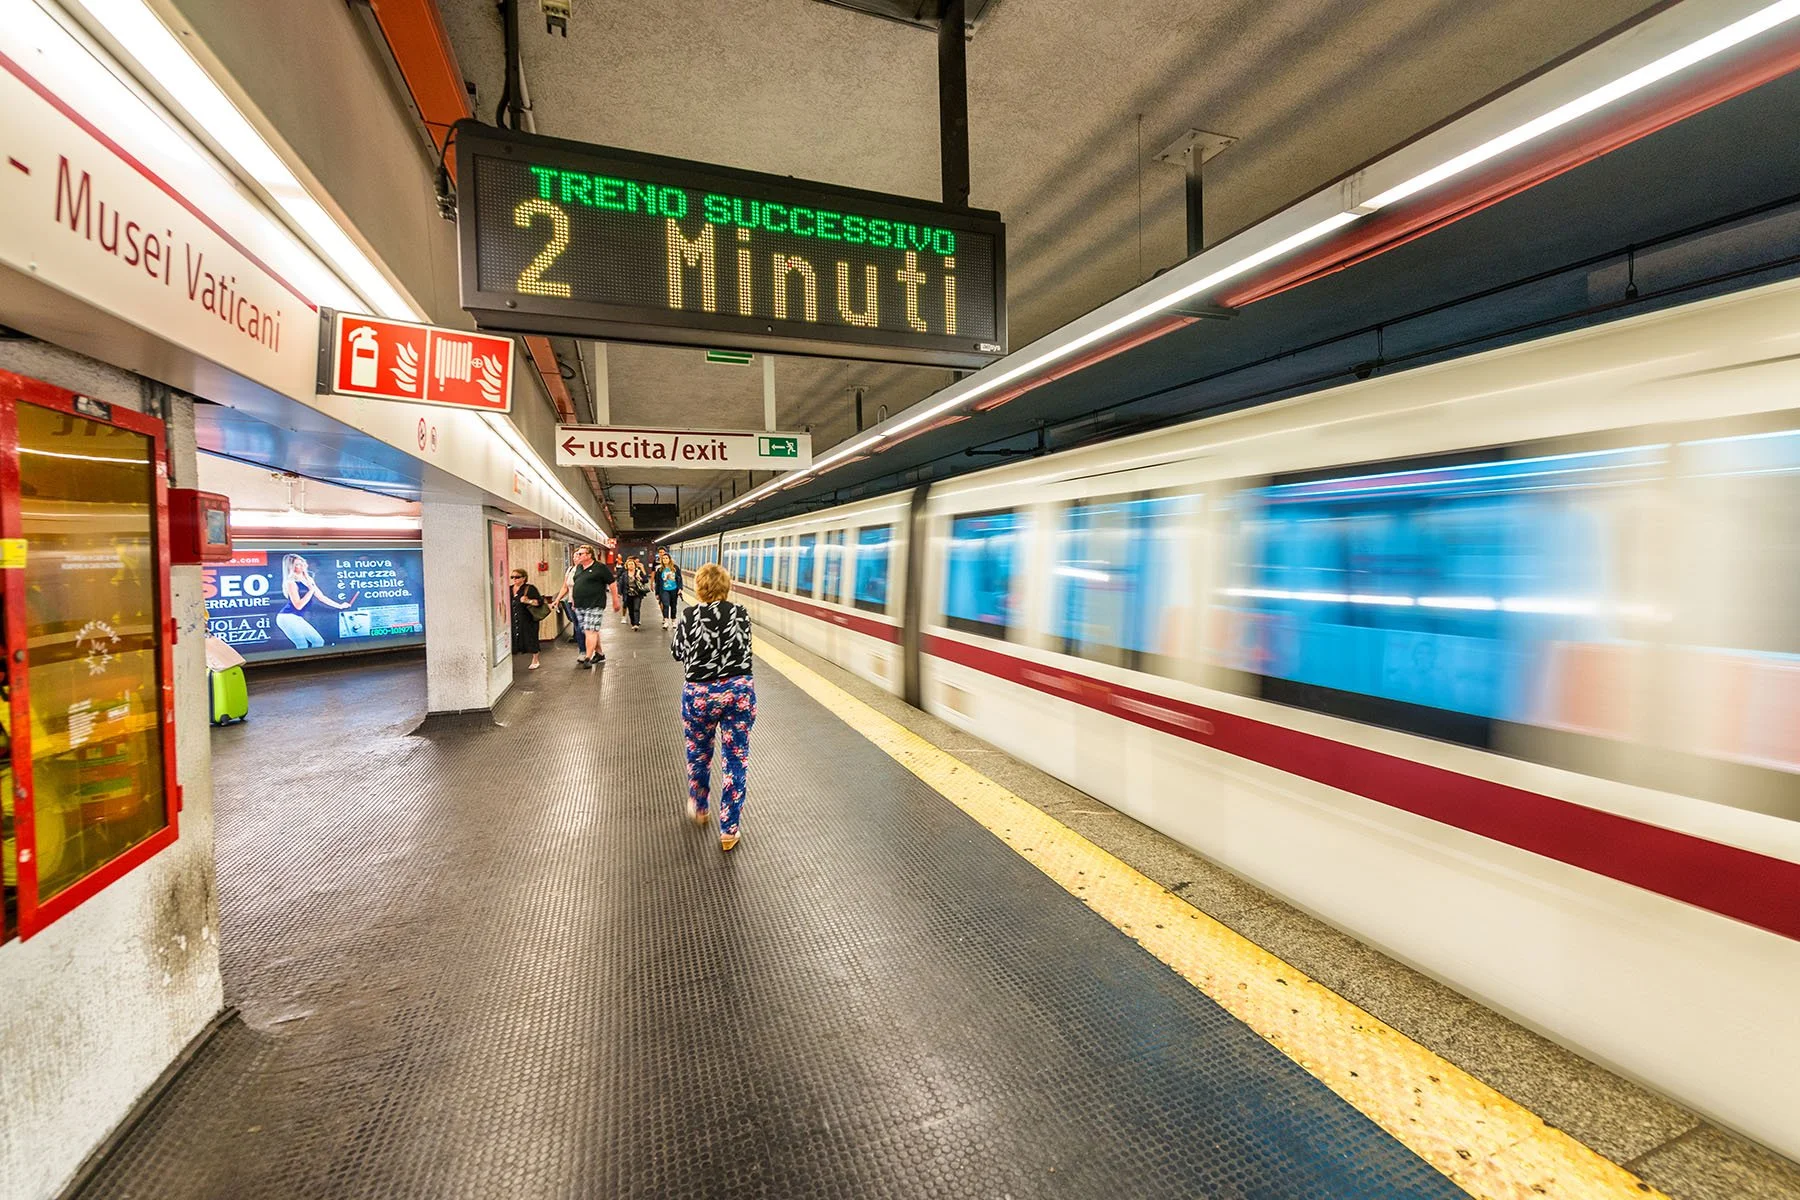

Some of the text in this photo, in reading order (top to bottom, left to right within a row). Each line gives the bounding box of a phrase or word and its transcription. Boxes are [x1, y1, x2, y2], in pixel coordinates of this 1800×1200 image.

[530, 166, 957, 255] TRENO SUCCESSIVO
[55, 154, 172, 286] Musei
[185, 242, 281, 353] Vaticani
[514, 198, 957, 336] 2 Minuti
[589, 436, 728, 462] uscita/exit
[336, 559, 392, 569] La nuova
[336, 570, 397, 579] sicurezza
[337, 578, 404, 589] è flessibile
[338, 588, 412, 600] e comoda.
[256, 617, 270, 629] di
